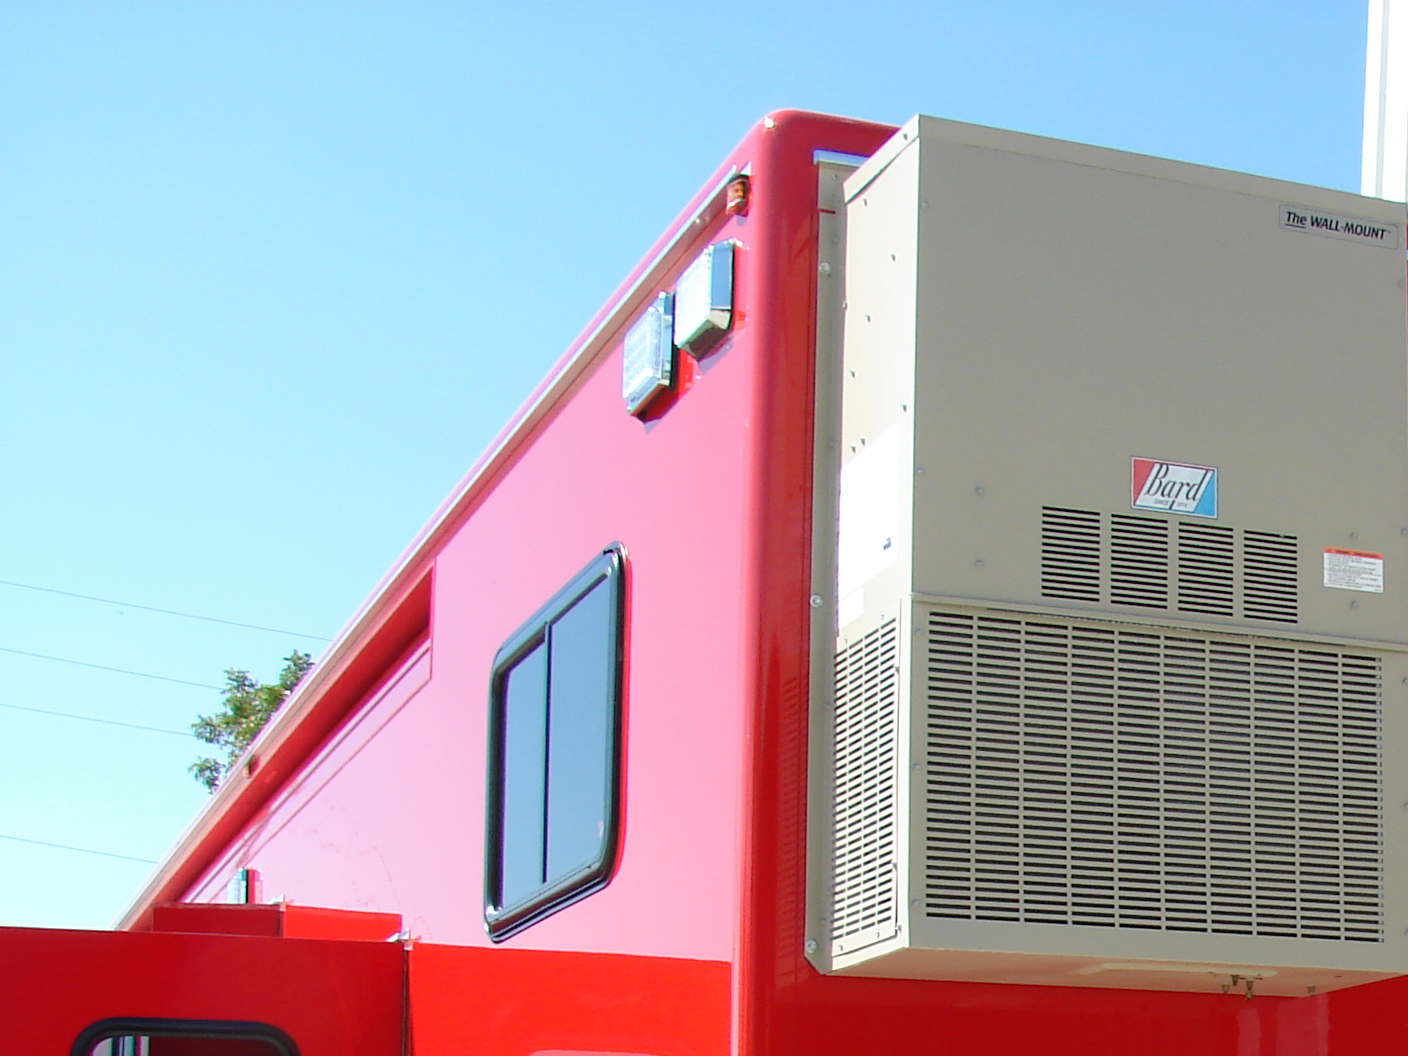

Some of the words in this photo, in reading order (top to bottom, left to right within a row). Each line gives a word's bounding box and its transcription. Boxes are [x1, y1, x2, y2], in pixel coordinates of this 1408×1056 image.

[1285, 211, 1307, 228] The
[1310, 215, 1387, 240] WALL-MOUNT
[1144, 463, 1209, 502] Bard
